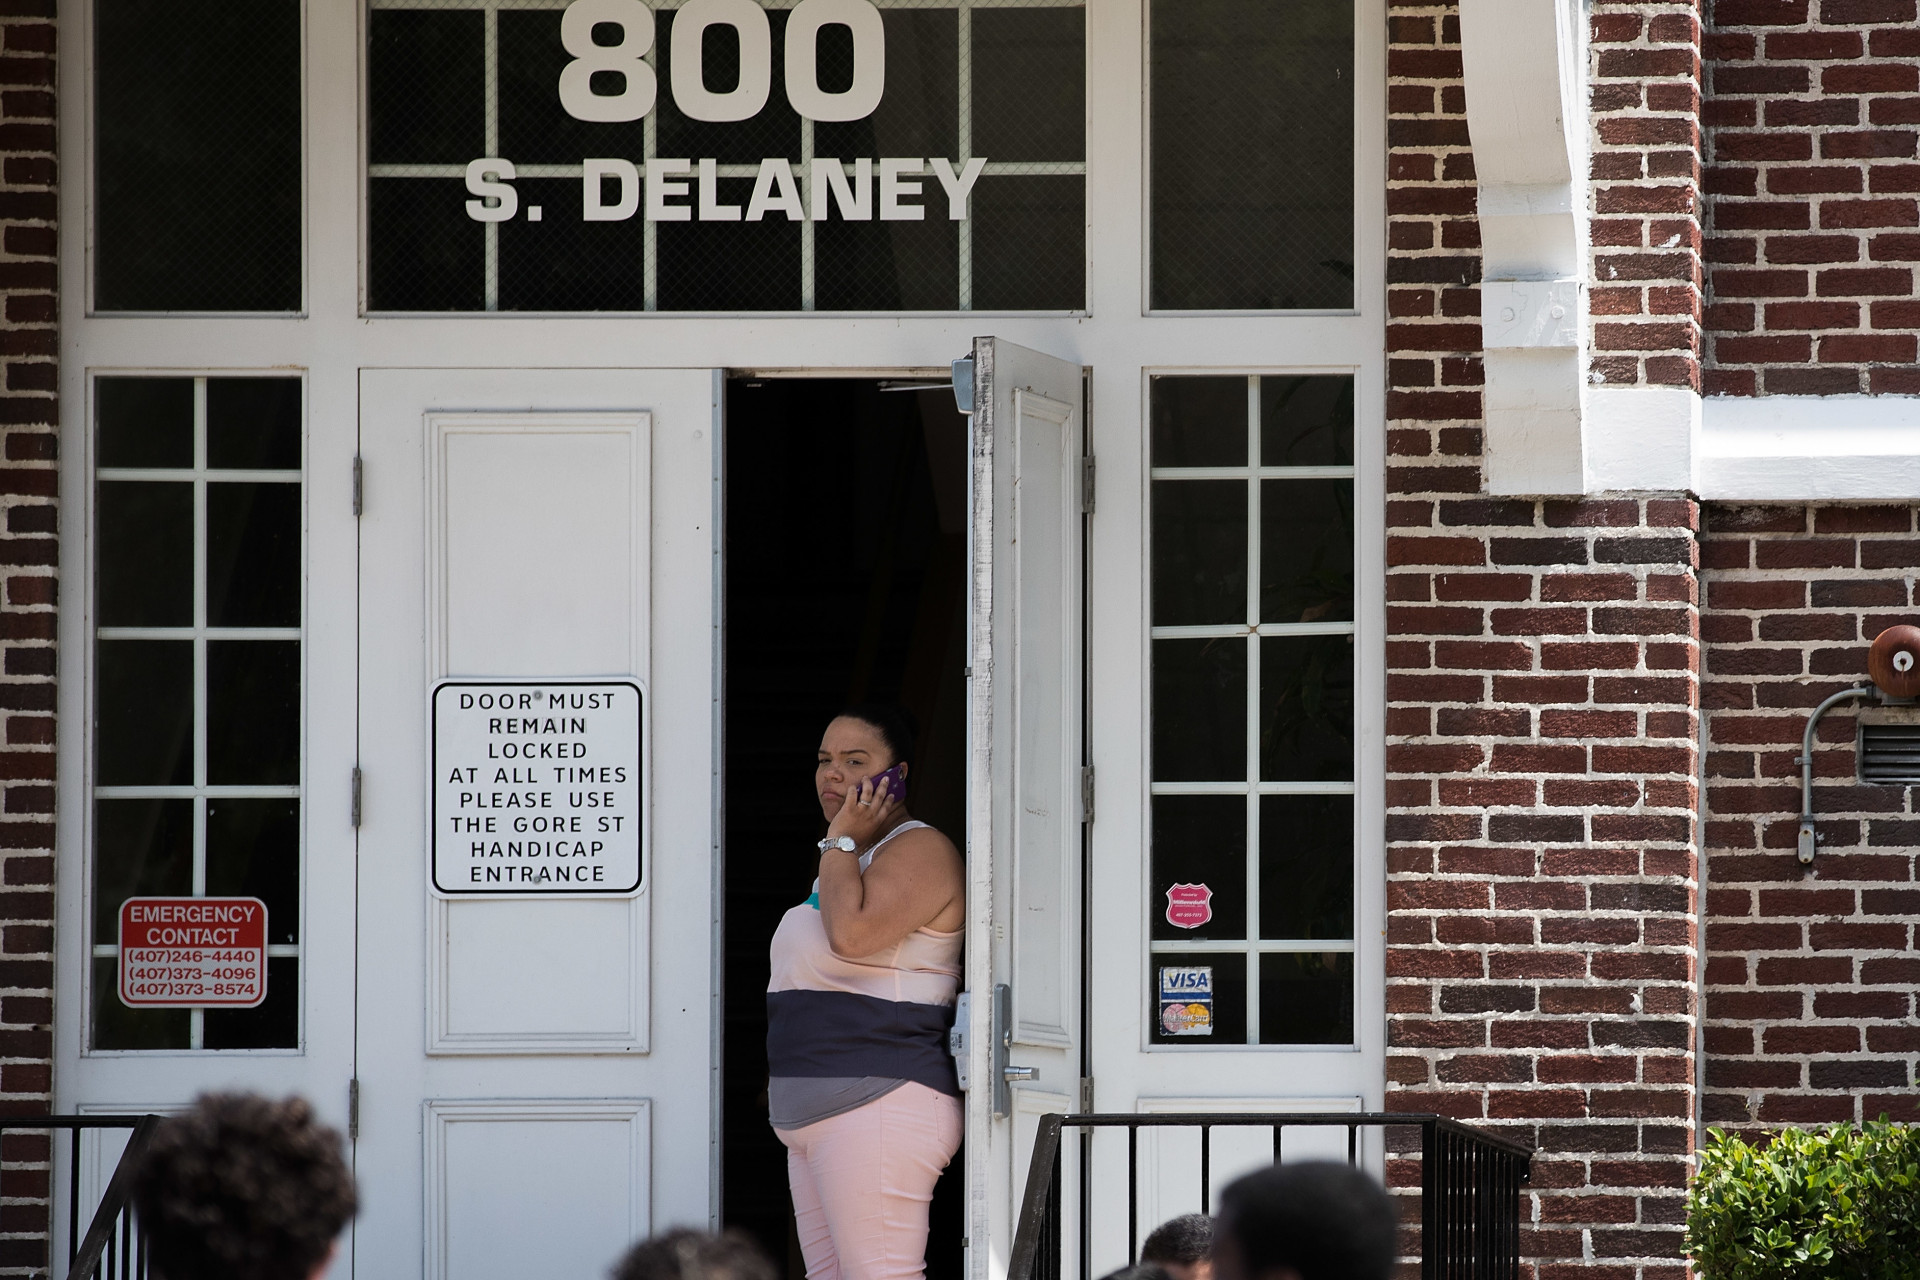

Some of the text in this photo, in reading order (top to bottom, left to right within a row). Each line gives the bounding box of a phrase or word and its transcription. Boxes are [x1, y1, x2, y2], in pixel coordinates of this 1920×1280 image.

[558, 0, 886, 122] 800
[464, 157, 988, 222] S. DELANEY
[460, 693, 615, 710] DOOR MUST
[489, 718, 585, 734] REMAIN
[488, 742, 587, 759] LOCKED
[448, 766, 627, 784] AT ALL TIMES
[460, 791, 615, 809] PLEASE USE
[450, 816, 625, 833] THE GORE ST
[471, 841, 604, 858] HANDICAP
[470, 865, 604, 883] ENTRANCE
[130, 905, 256, 923] EMERGENCY
[146, 928, 240, 945] CONTACT
[128, 949, 256, 964] (407)246-4440
[129, 966, 256, 981] (407)373-4096
[1167, 972, 1208, 988] VISA
[129, 982, 256, 997] (407)373-8574
